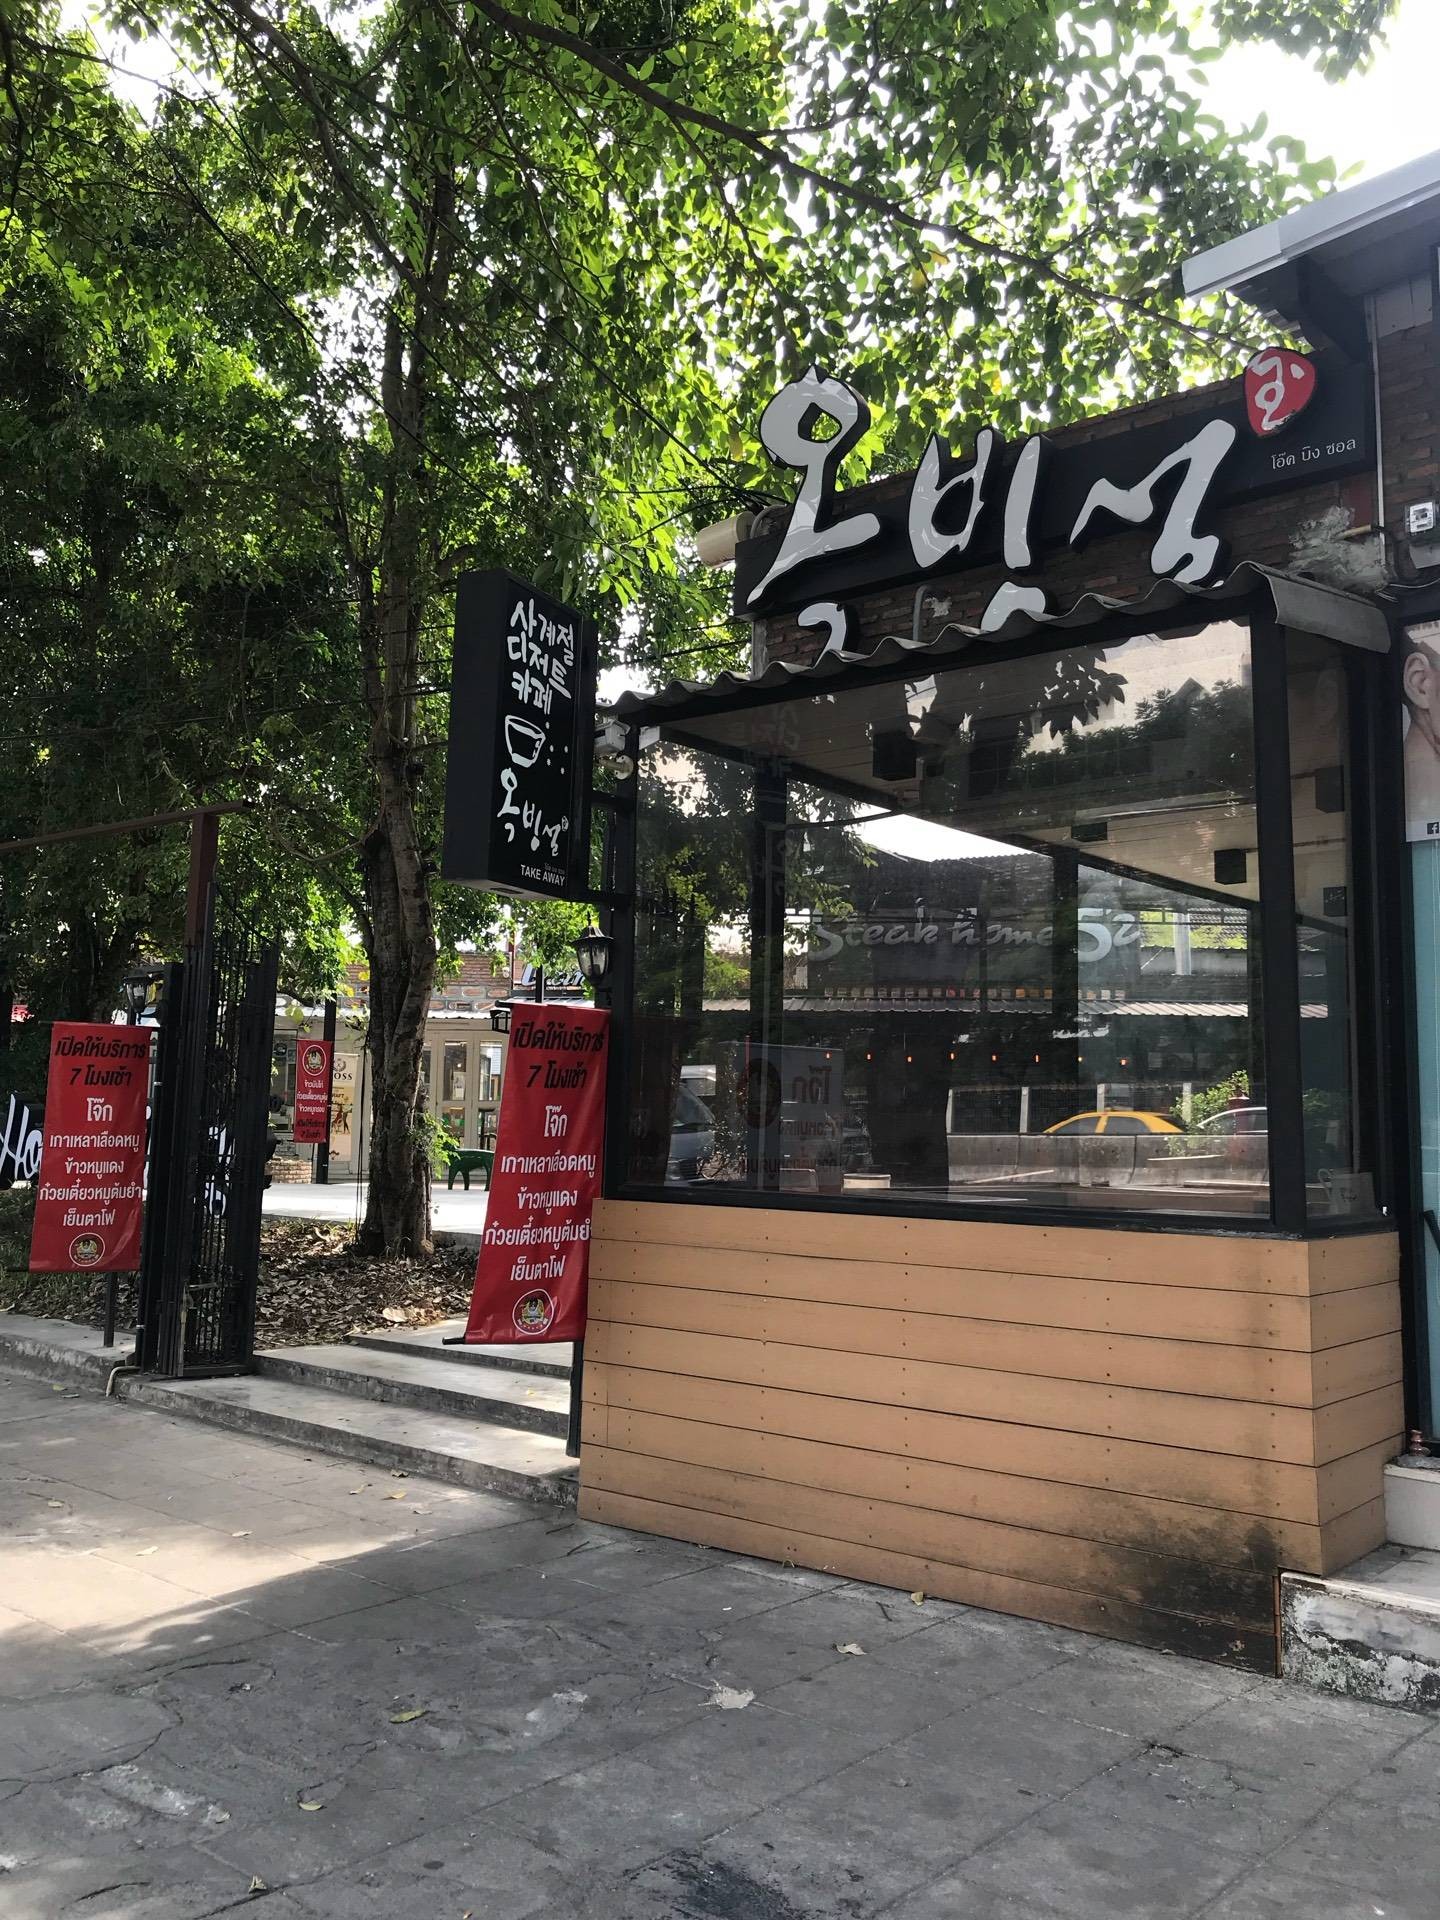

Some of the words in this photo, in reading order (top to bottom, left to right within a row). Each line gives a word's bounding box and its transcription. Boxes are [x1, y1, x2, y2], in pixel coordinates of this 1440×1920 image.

[507, 630, 572, 700] 디저트
[511, 668, 552, 715] 카페
[520, 864, 541, 880] TAKE
[542, 871, 565, 887] AWAY
[55, 1035, 147, 1059] เปิดให้บริการ
[513, 1020, 605, 1053] เปิดให้บริการ
[69, 1068, 82, 1086] 7
[84, 1064, 132, 1086] โมงเช้า
[333, 1072, 353, 1081] OSS
[526, 1065, 540, 1088] 7
[544, 1060, 588, 1089] โมงเช้า
[86, 1097, 113, 1122] โจ๊ก
[544, 1105, 568, 1138] โจ๊ก
[49, 1130, 140, 1153] เกาเหลาเลือดหมู
[65, 1156, 125, 1179] ข้าวหมูแดง
[501, 1150, 596, 1178] เกาเหลาเลือดหมู
[518, 1186, 578, 1215] ข้าวหมูแดง
[62, 1207, 116, 1227] เย็นตาโฟ
[510, 1255, 566, 1282] เย็นตาโฟ
